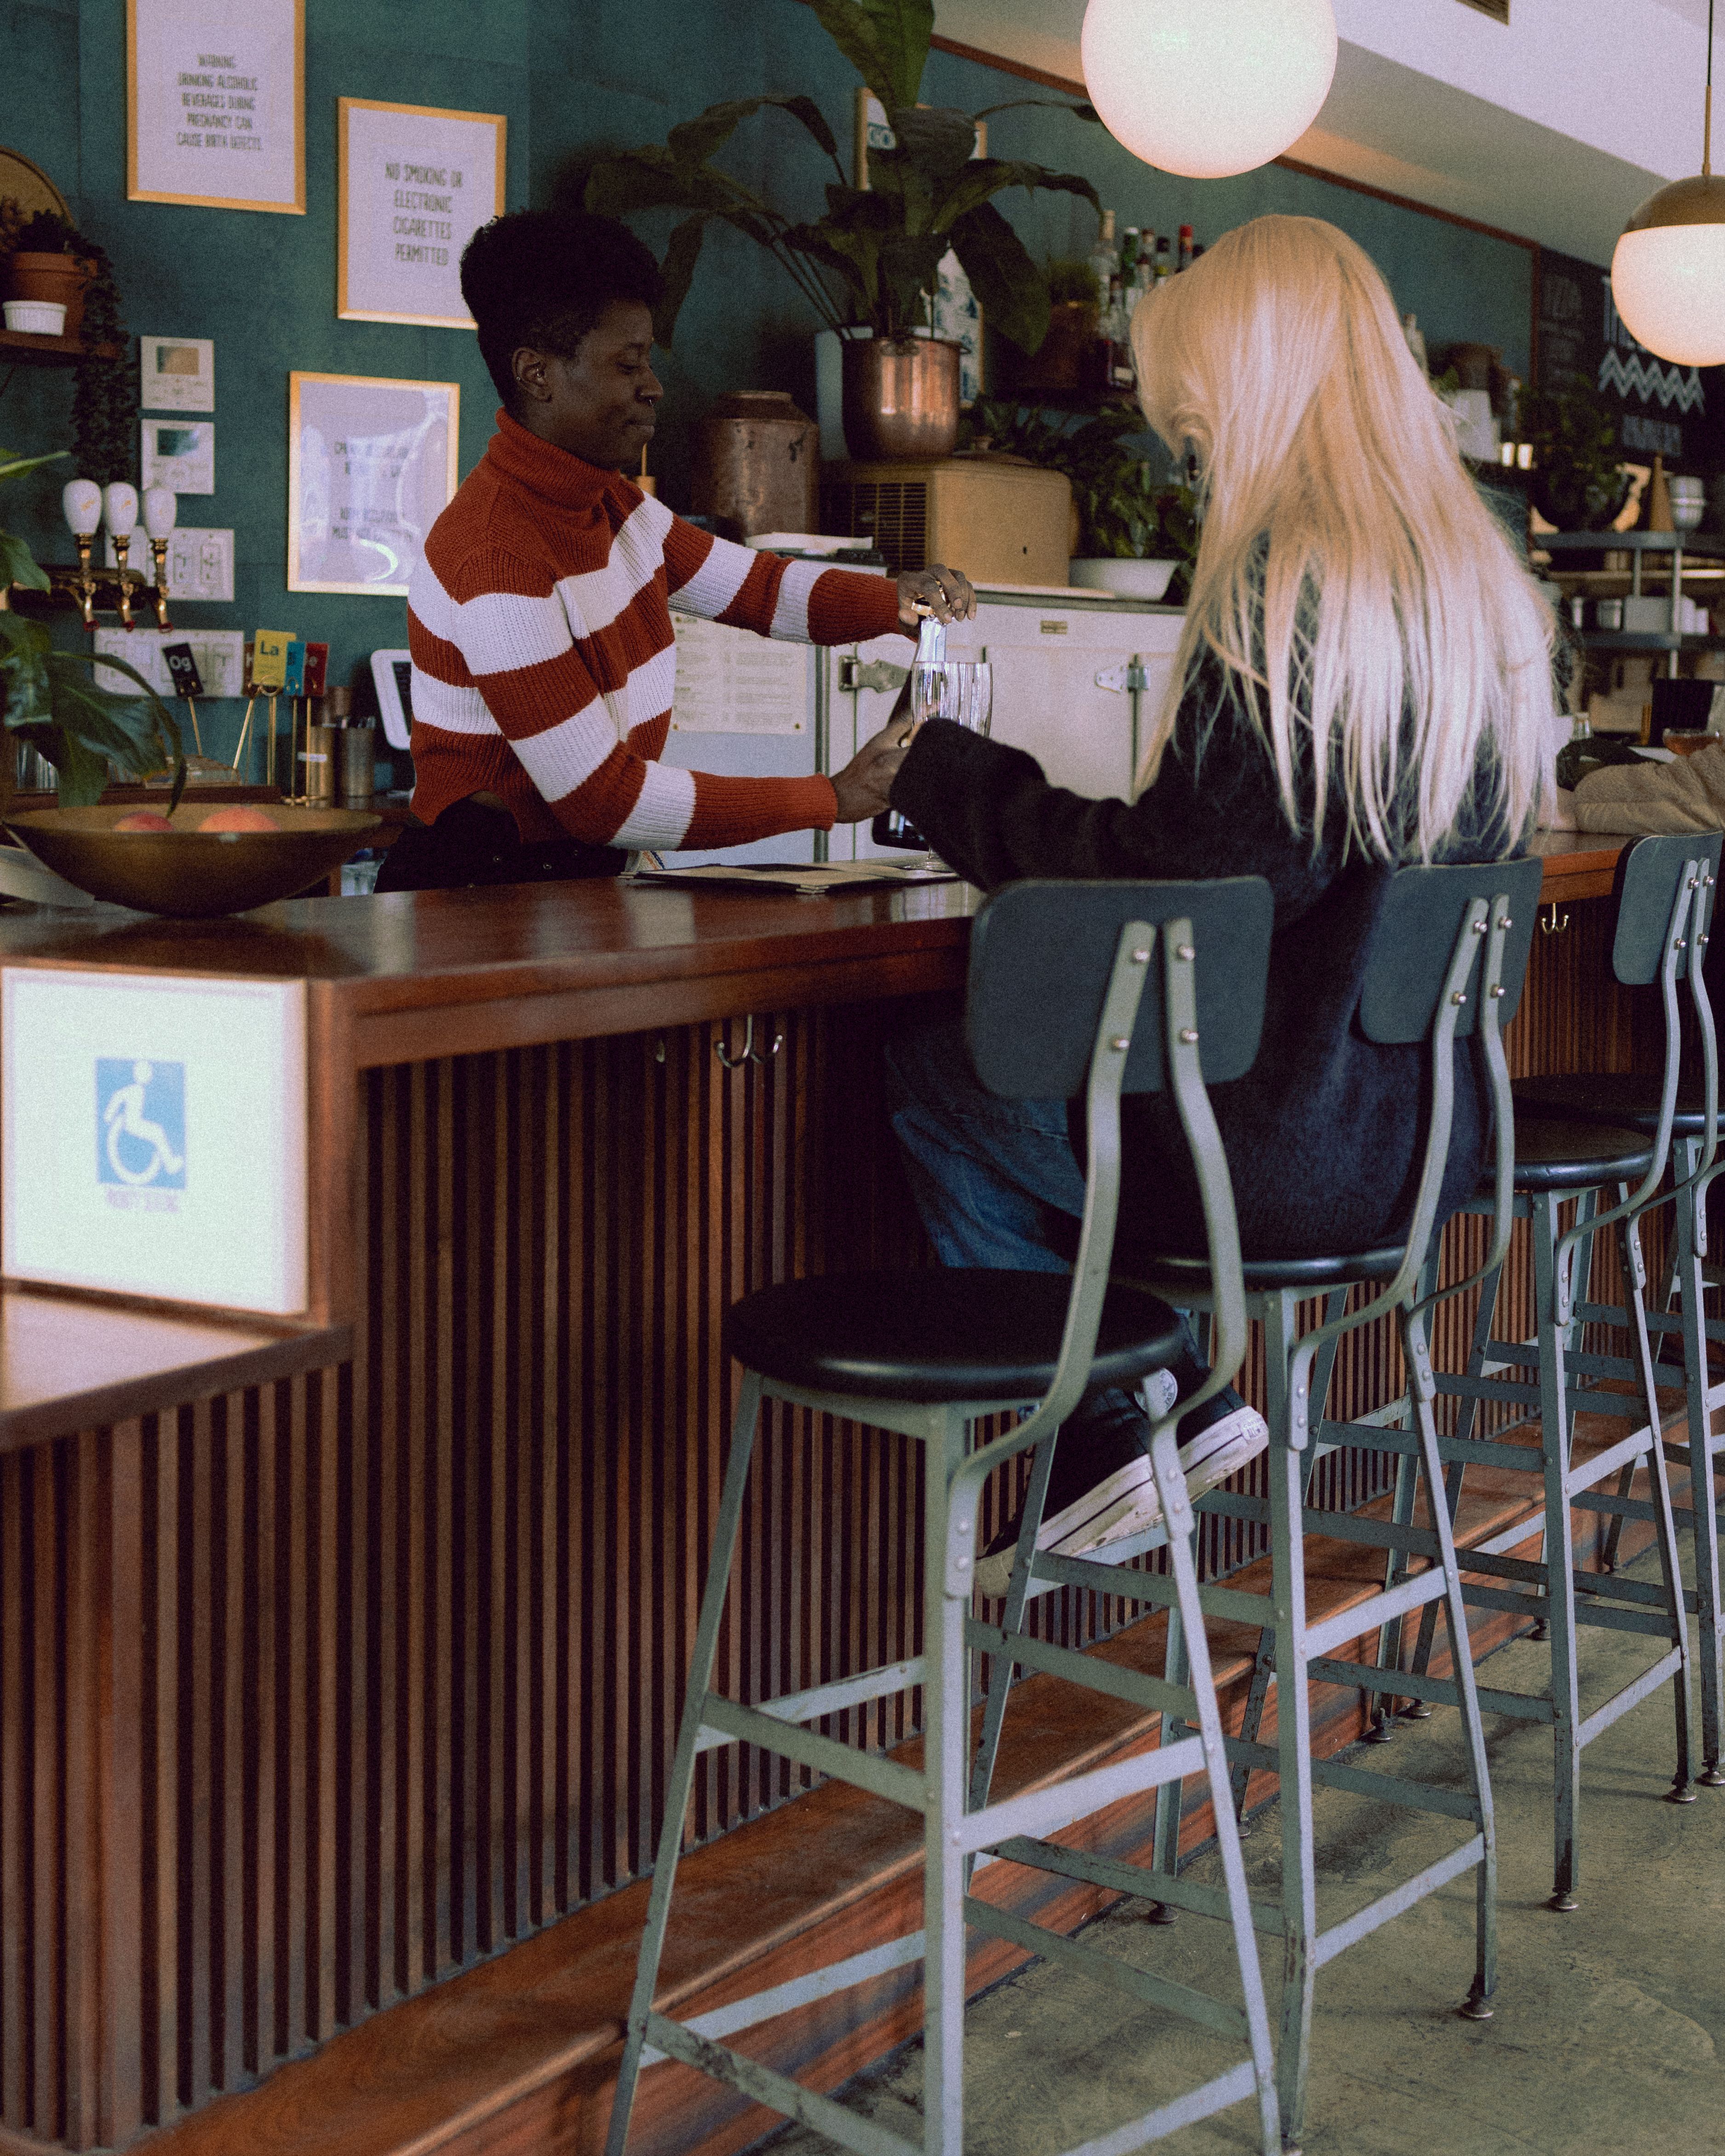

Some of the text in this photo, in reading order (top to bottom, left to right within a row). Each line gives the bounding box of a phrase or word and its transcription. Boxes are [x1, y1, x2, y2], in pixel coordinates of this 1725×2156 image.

[217, 75, 258, 91] ALCOHOLIC
[182, 92, 225, 108] BEVERAGES
[186, 113, 252, 130] PREGNANCY CAN
[176, 132, 201, 147] CAUSE
[205, 134, 227, 148] BIRTH
[385, 162, 462, 188] NO SMOKING OR
[394, 189, 453, 213] ELECTRONIC
[393, 216, 452, 240] CIGARETTES
[395, 243, 448, 265] PERMITTED
